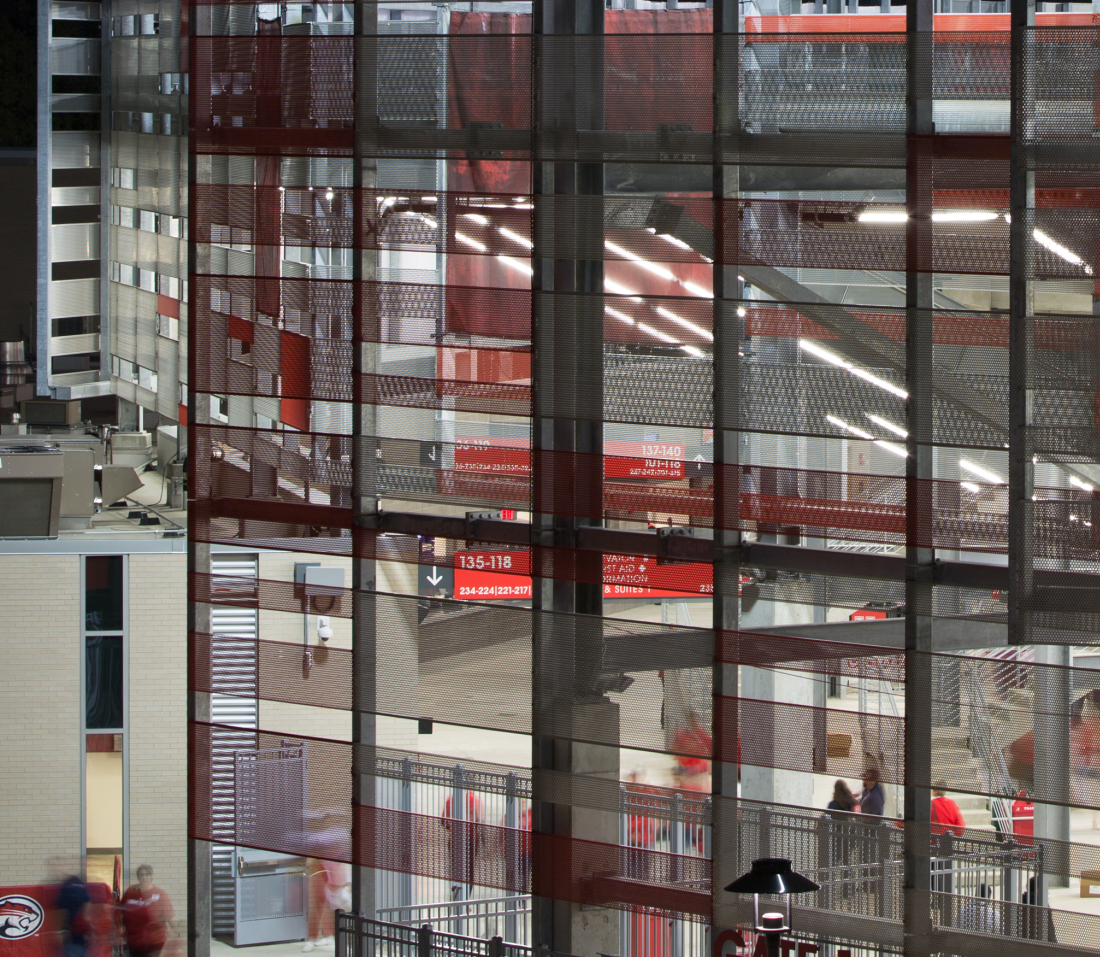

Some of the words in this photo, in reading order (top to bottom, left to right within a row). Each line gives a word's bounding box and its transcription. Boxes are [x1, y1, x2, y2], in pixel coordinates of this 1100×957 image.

[642, 445, 681, 457] 137-140
[460, 555, 512, 569] 135-118
[604, 585, 612, 593] &
[614, 584, 644, 594] SUITES
